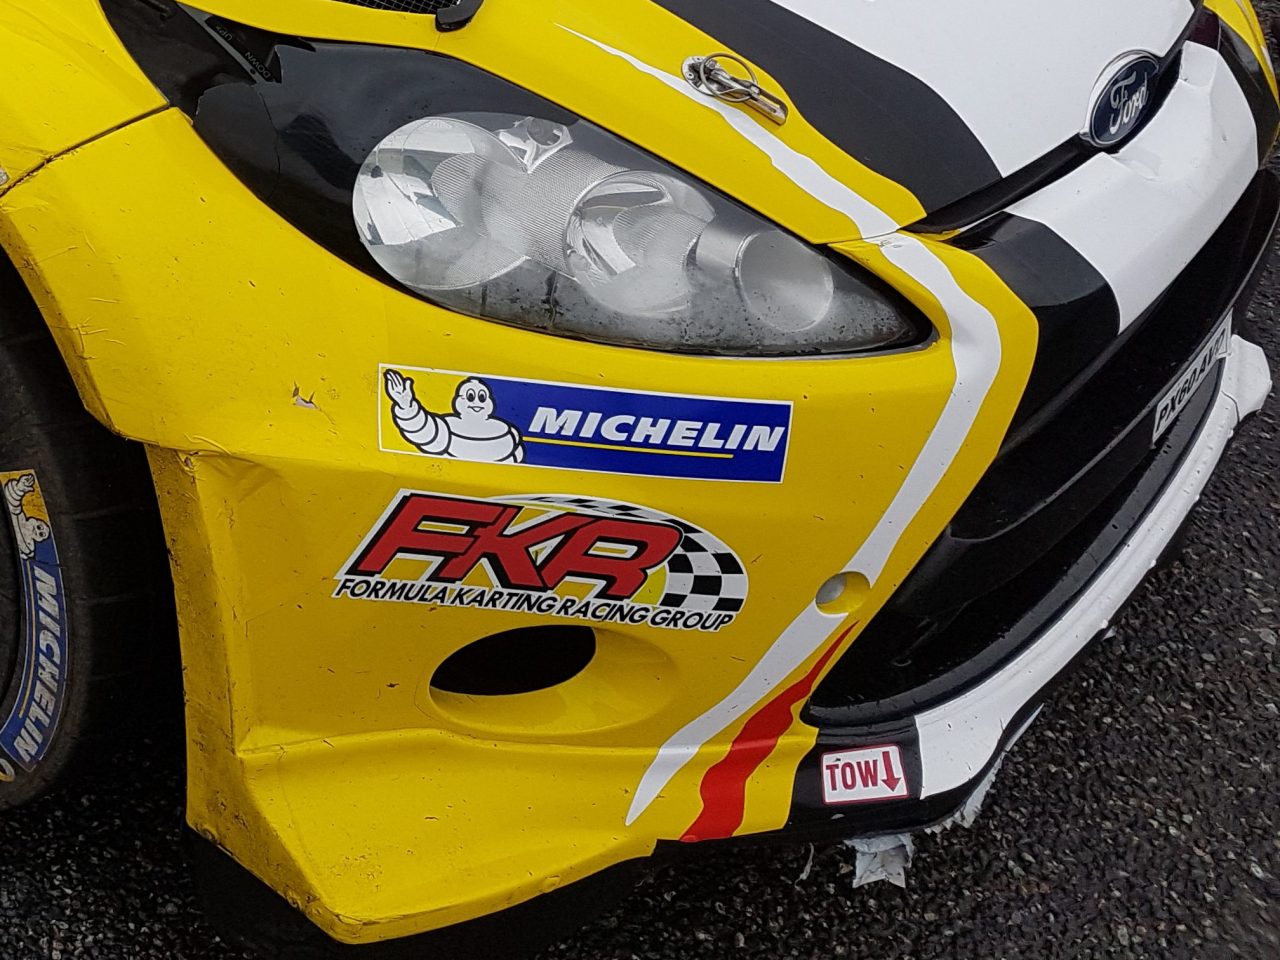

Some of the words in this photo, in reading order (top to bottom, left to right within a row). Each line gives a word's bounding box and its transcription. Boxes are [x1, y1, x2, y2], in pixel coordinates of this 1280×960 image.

[1109, 71, 1150, 135] Ford
[528, 406, 786, 452] MICHELIN
[1155, 368, 1197, 434] PX60
[352, 493, 685, 601] FKR
[335, 578, 445, 604] FORMULA
[450, 587, 558, 614] KARTING
[556, 596, 651, 624] RACING
[649, 608, 735, 631] GROUP
[14, 566, 63, 762] MICHELIN
[825, 759, 879, 792] TOW
